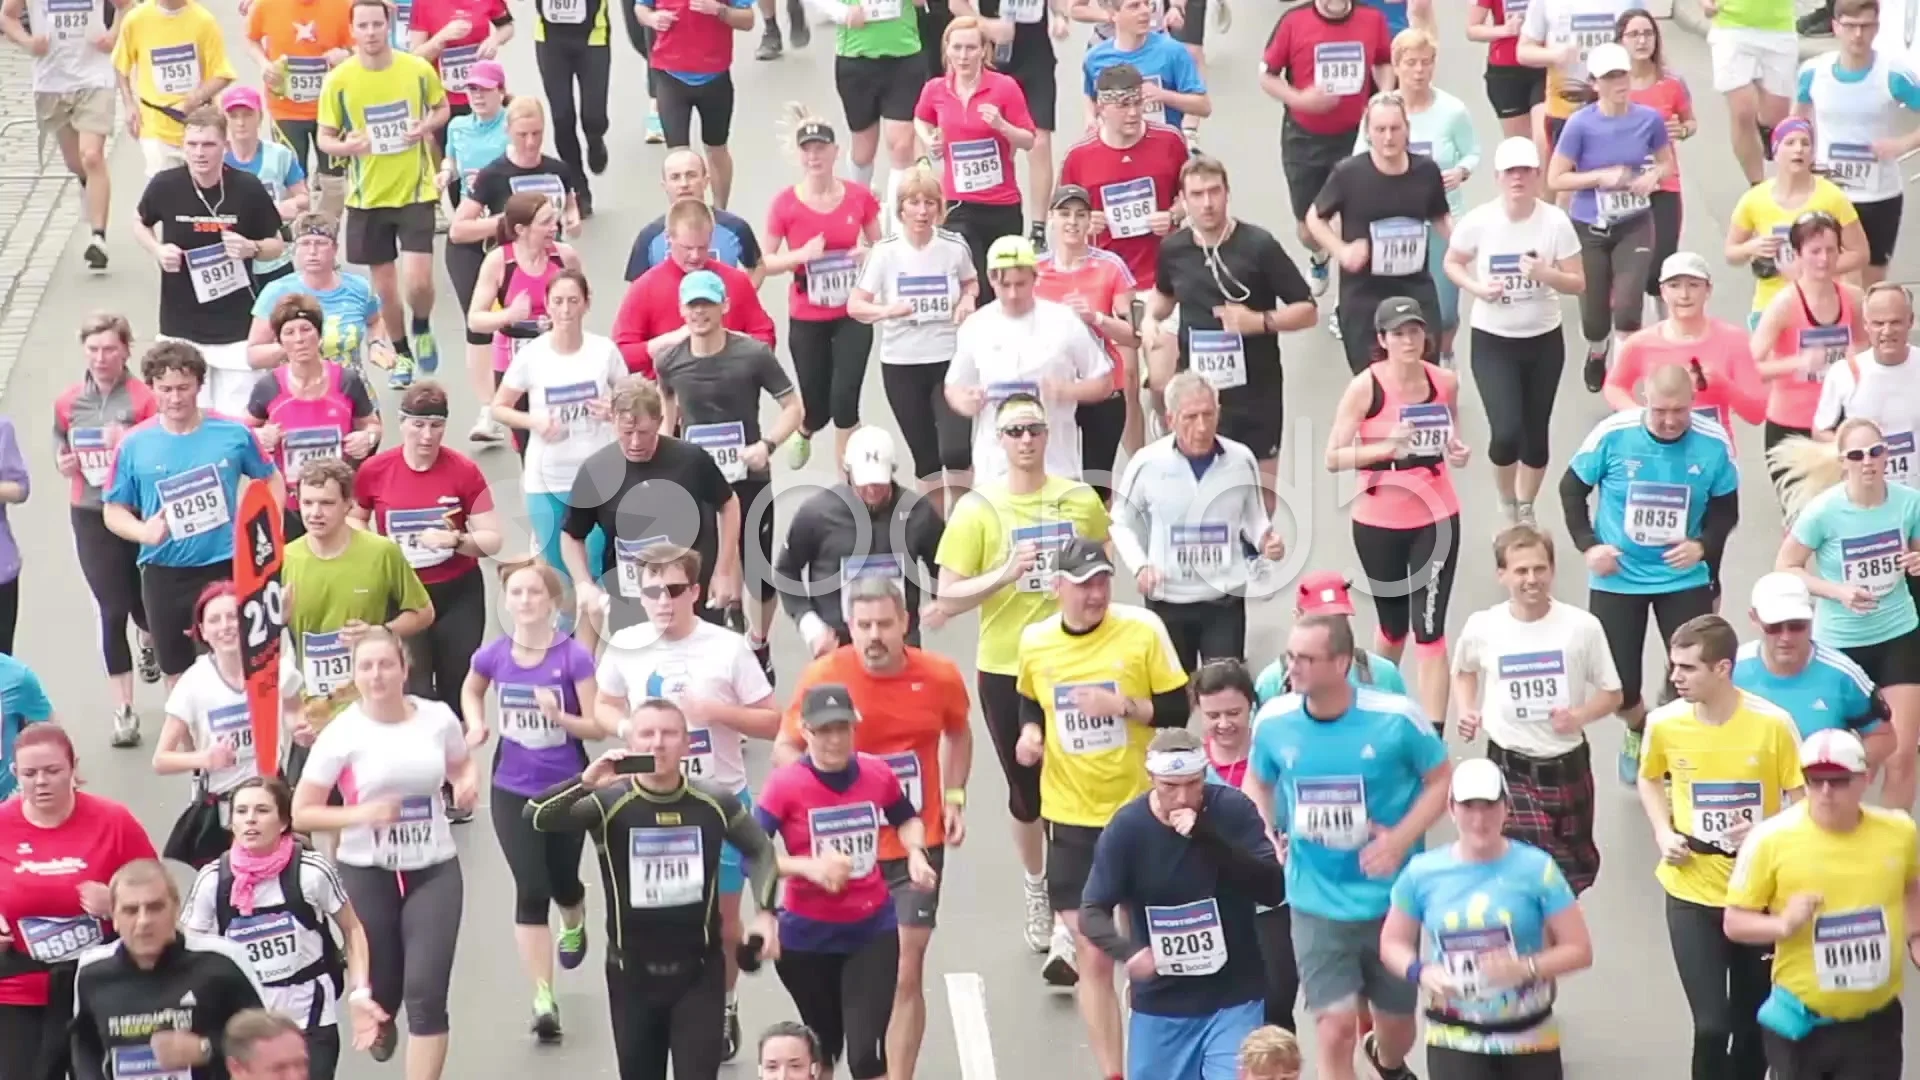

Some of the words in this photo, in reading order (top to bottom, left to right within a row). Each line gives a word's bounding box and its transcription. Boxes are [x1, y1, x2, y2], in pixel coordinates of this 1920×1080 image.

[963, 158, 999, 177] 5365
[173, 491, 218, 519] 8295
[243, 580, 285, 648] 20
[1509, 677, 1557, 700] 9193
[245, 933, 297, 962] 3857
[1161, 931, 1214, 956] 8203
